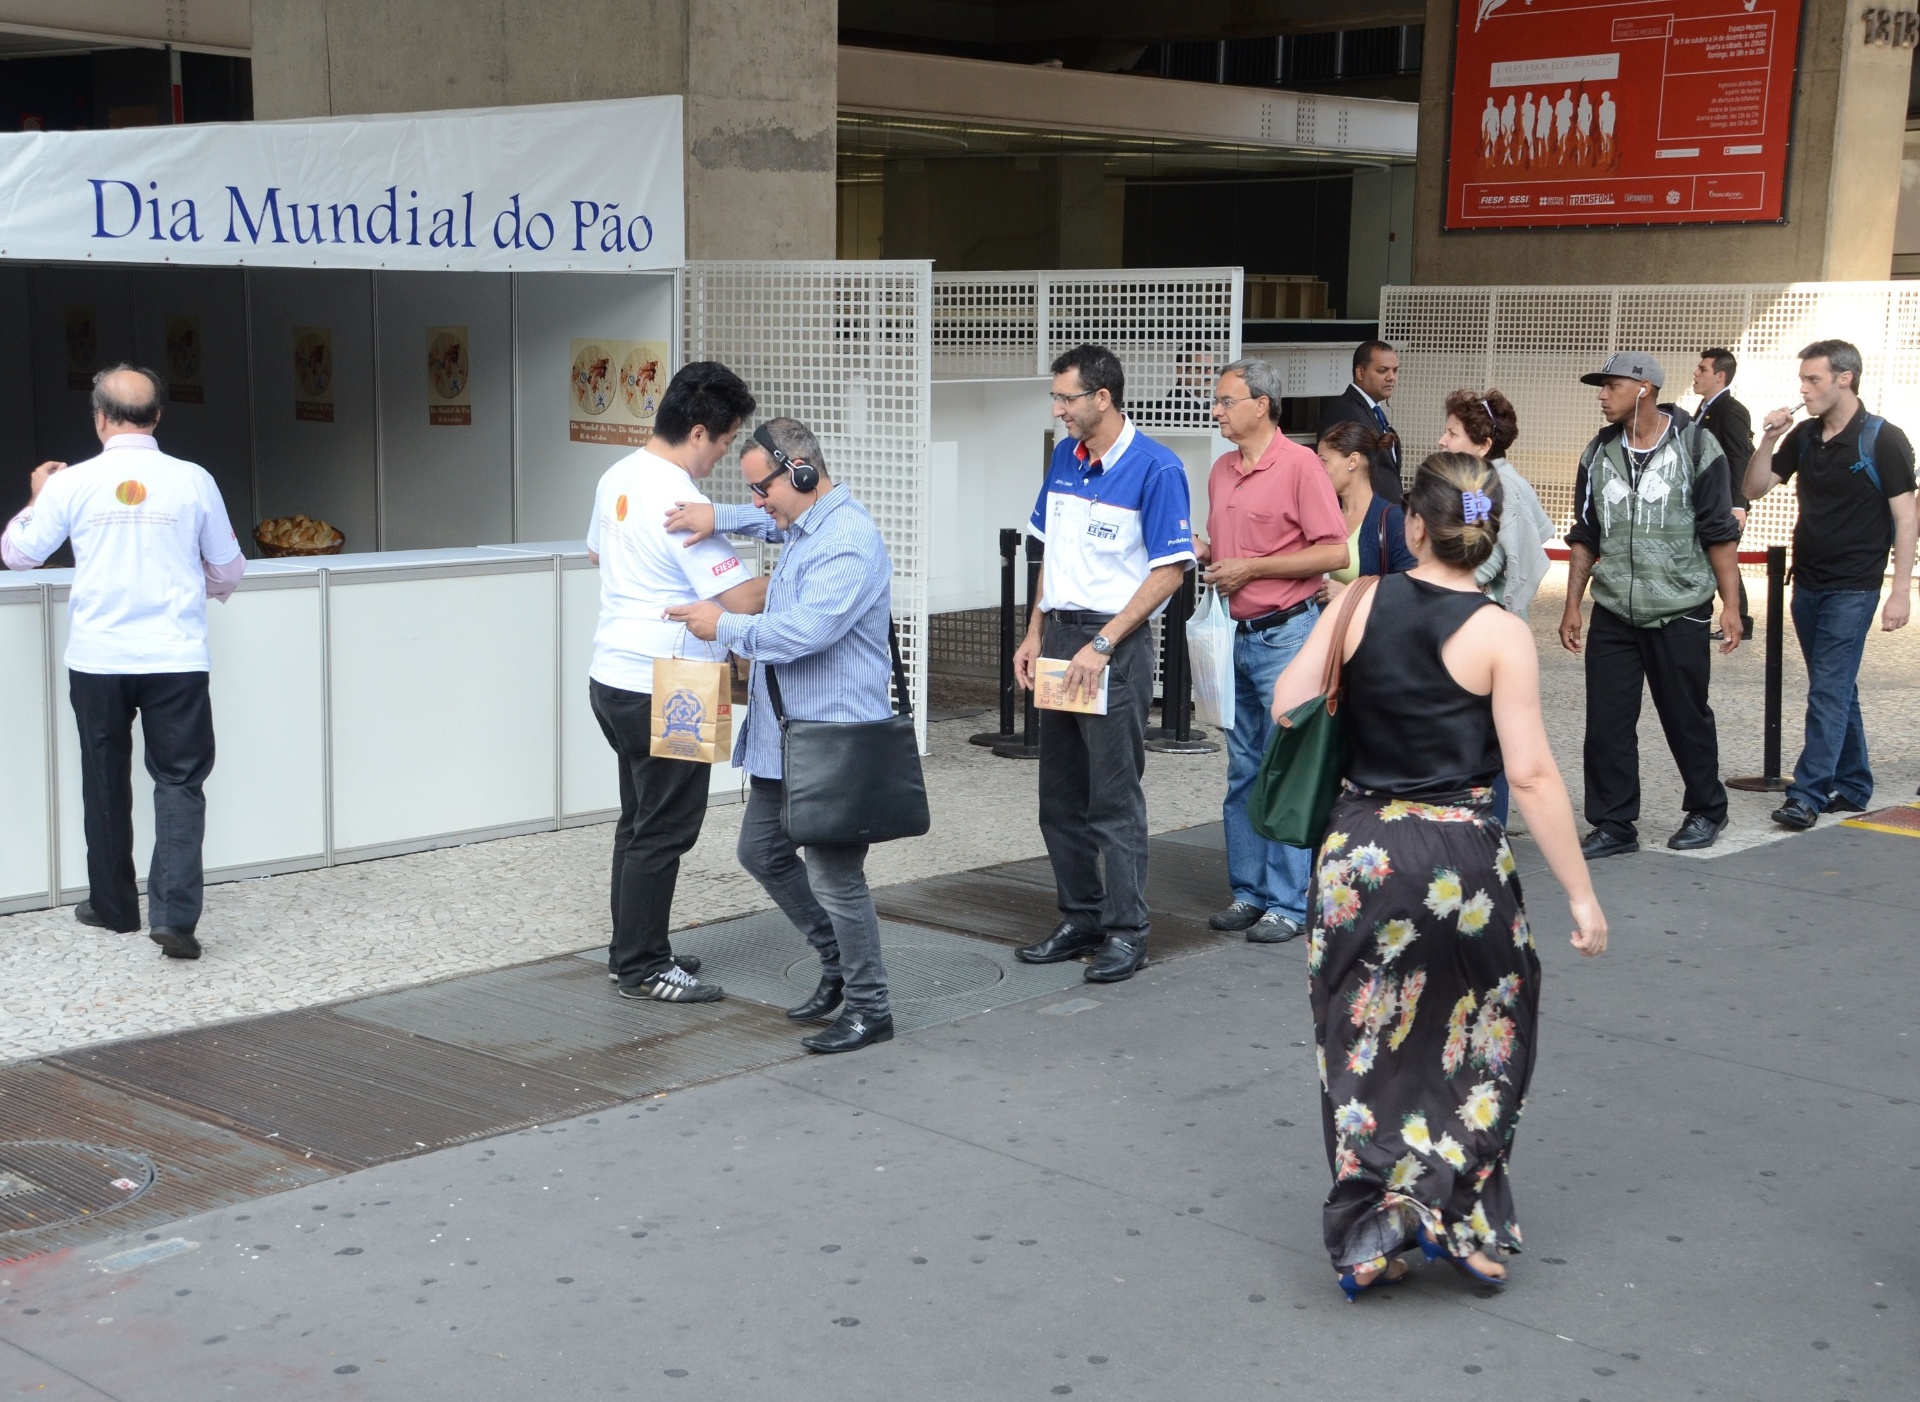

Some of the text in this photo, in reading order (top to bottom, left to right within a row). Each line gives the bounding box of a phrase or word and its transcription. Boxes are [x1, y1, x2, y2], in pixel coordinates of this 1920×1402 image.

[1728, 25, 1745, 33] Espaço
[1480, 195, 1530, 204] FIESP SESI
[1570, 194, 1615, 206] TRANSFORM
[88, 179, 653, 252] Dia Mundial do Pão
[714, 558, 736, 575] FIESP
